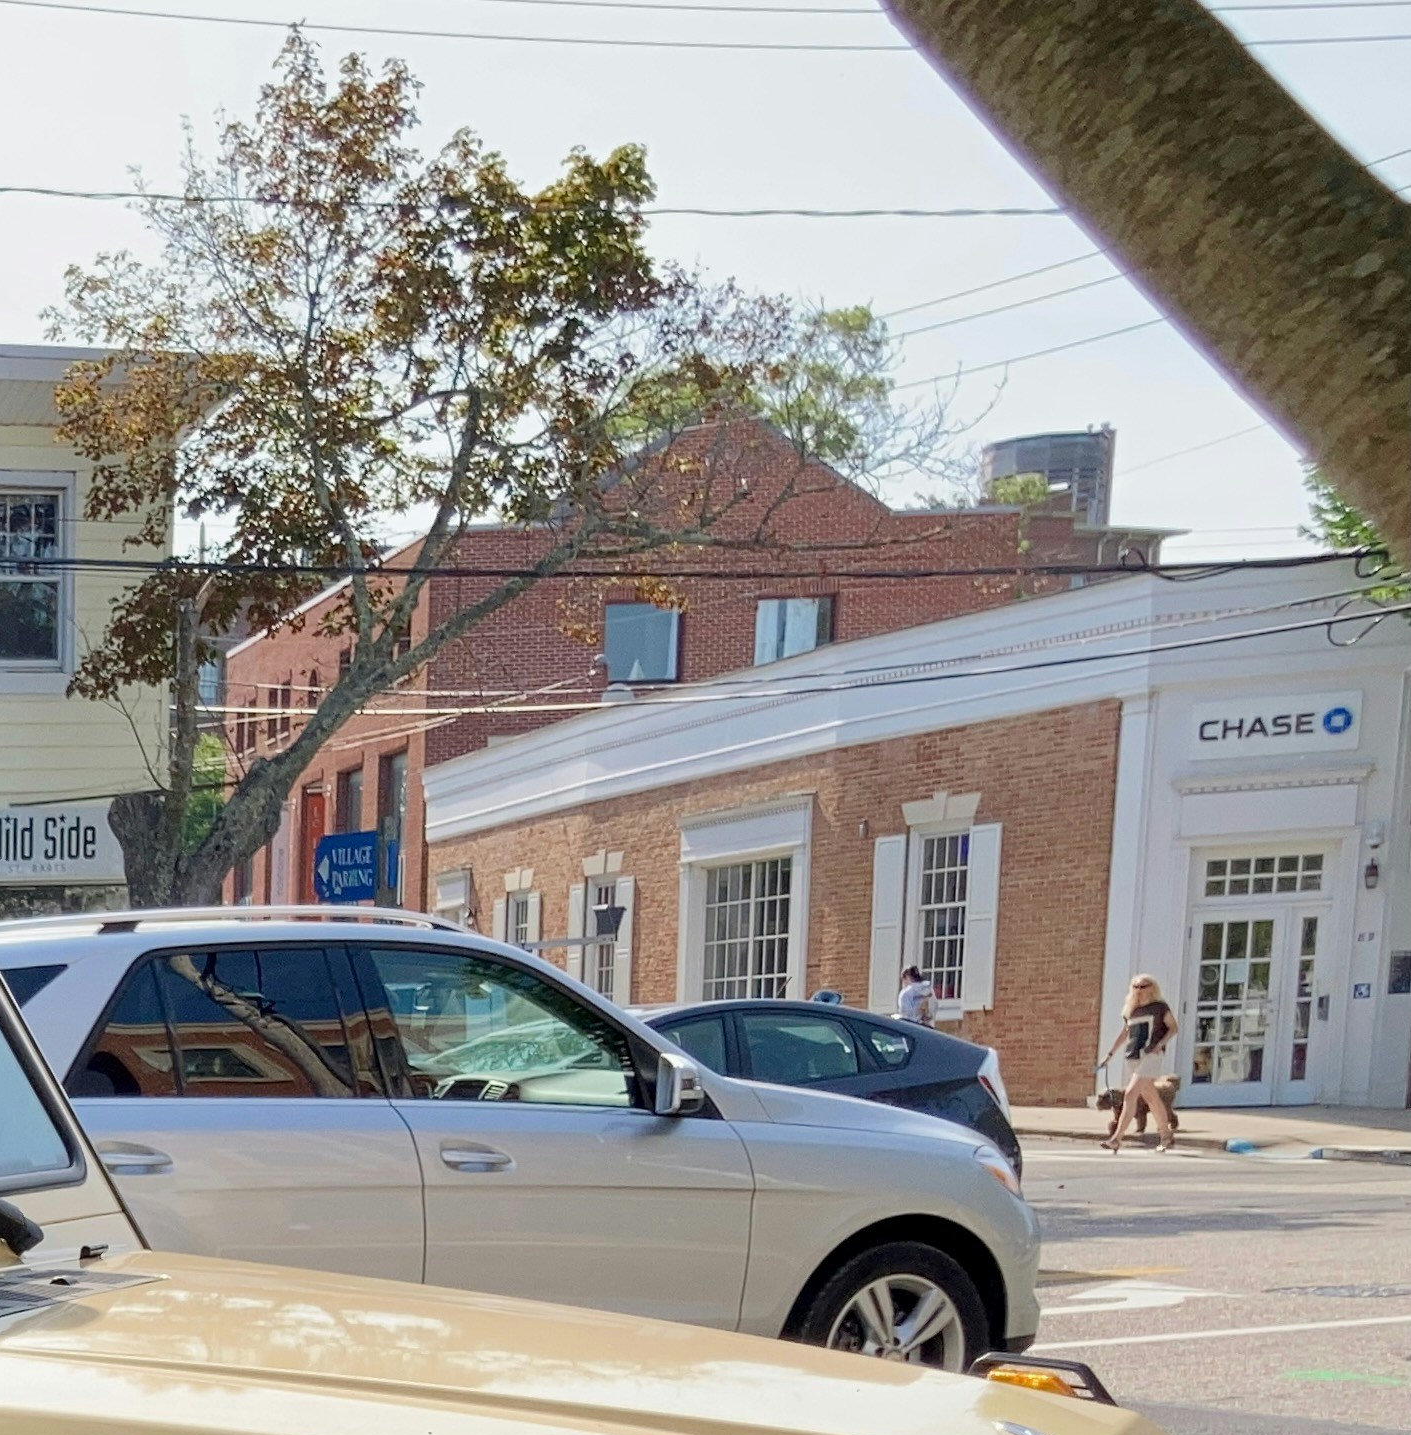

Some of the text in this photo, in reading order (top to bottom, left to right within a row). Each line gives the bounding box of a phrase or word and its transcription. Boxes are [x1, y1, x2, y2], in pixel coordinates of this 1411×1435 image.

[1199, 712, 1315, 742] CHASE
[44, 813, 96, 860] Side
[331, 846, 373, 866] VILLAGE
